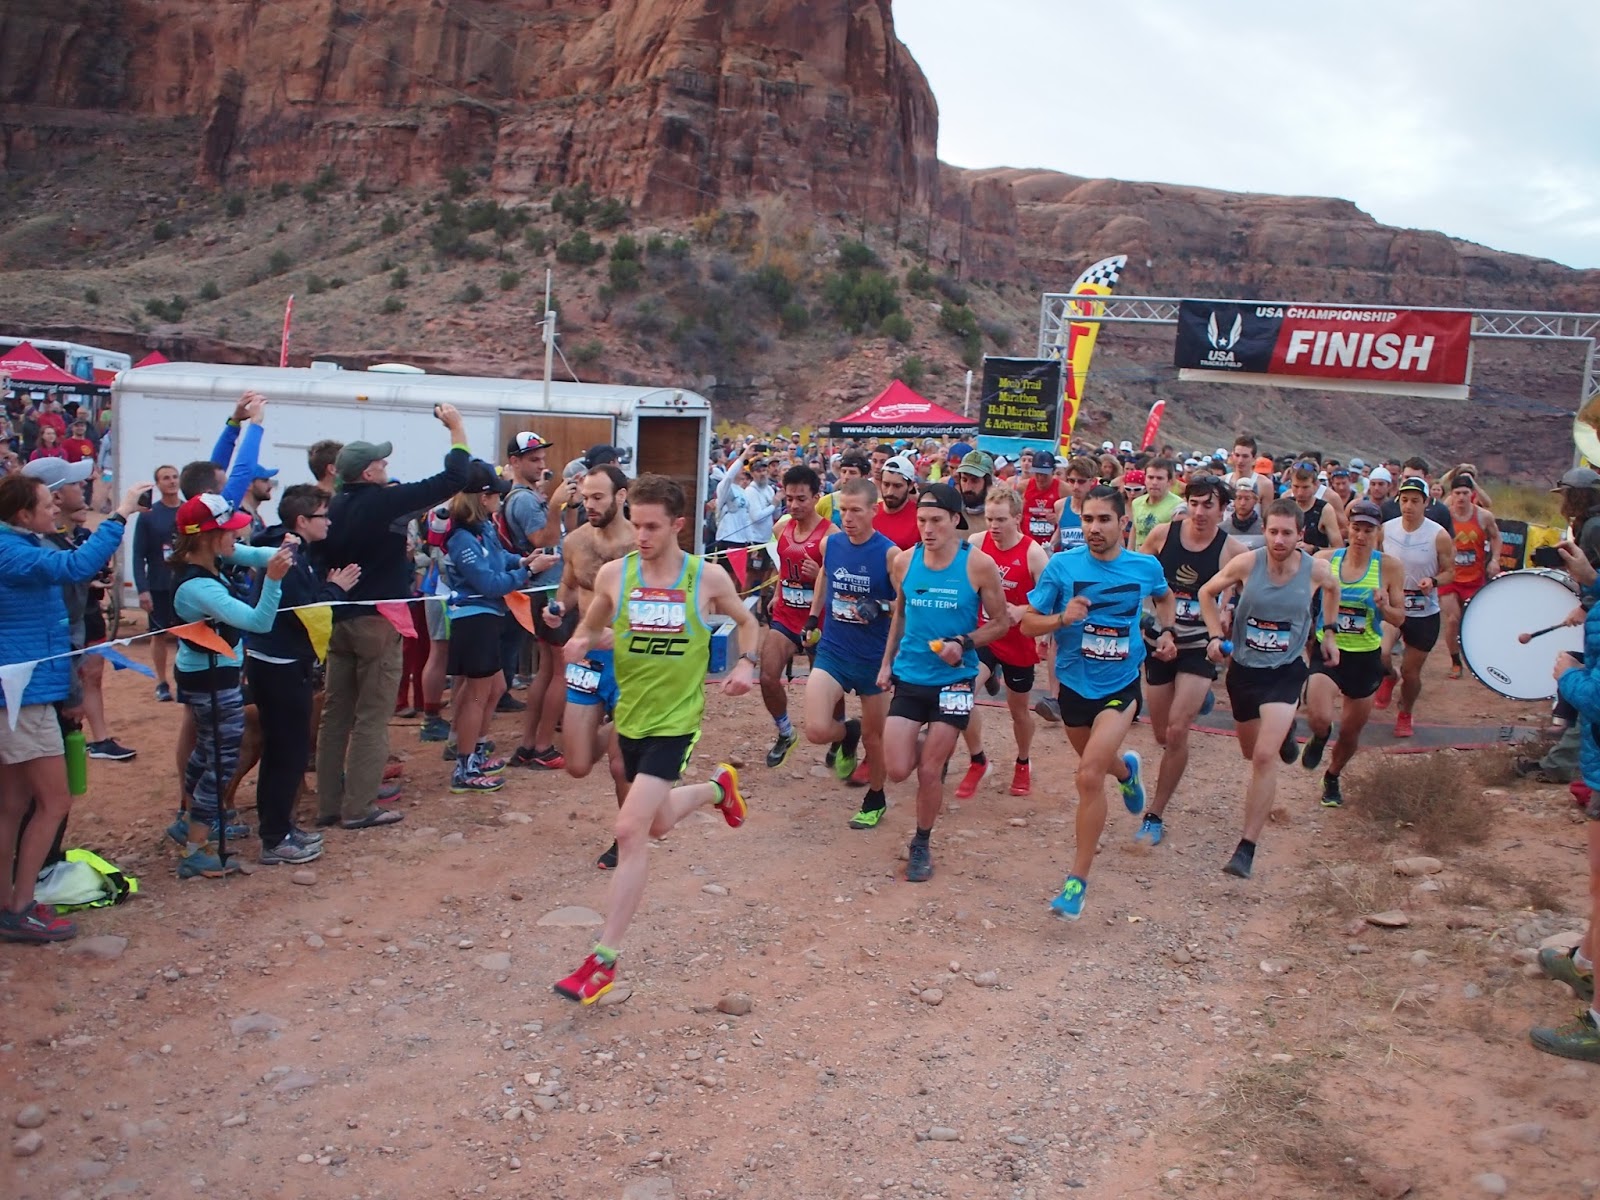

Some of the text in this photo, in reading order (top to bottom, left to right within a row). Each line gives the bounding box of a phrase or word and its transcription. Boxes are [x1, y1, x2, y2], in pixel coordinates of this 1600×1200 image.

[1256, 307, 1398, 323] USA CHAMPIONSHIP
[1208, 350, 1235, 362] USA
[1285, 330, 1435, 371] FINISH
[1023, 378, 1042, 390] Trail
[998, 391, 1039, 404] Marathon
[988, 403, 1048, 419] Half Marathon
[842, 425, 973, 435] www.RacingUnderground.com
[985, 418, 993, 428] &
[993, 418, 1036, 432] Adventure
[832, 581, 870, 593] RACE TEAM
[789, 589, 805, 605] 13
[911, 598, 958, 610] RACE TEAM
[1342, 616, 1351, 630] 8
[1095, 637, 1117, 656] 34
[1257, 631, 1278, 648] 12
